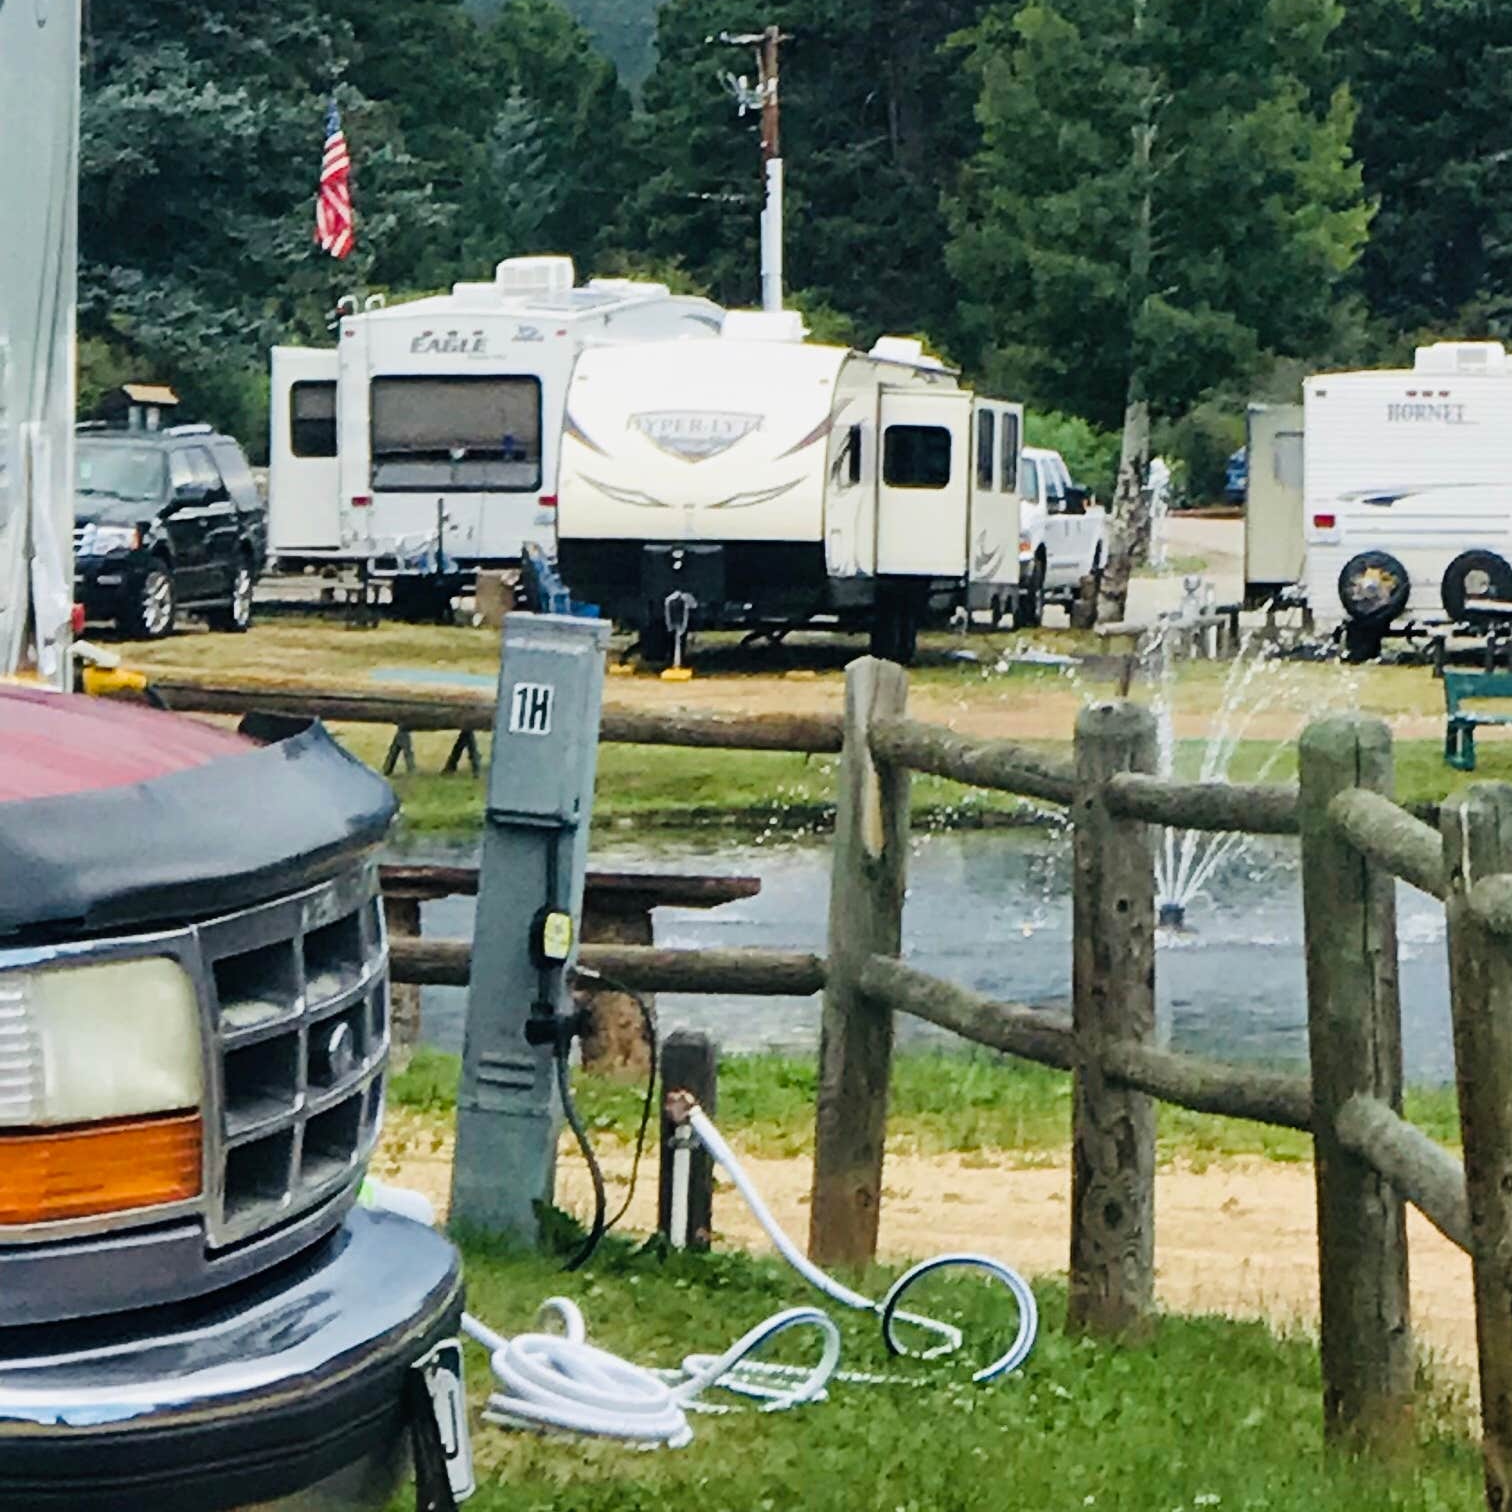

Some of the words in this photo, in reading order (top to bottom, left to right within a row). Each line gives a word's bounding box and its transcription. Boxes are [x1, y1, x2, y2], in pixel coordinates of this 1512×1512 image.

[410, 336, 487, 354] EAGLE
[1386, 403, 1465, 423] HORNET
[517, 687, 549, 730] 1H
